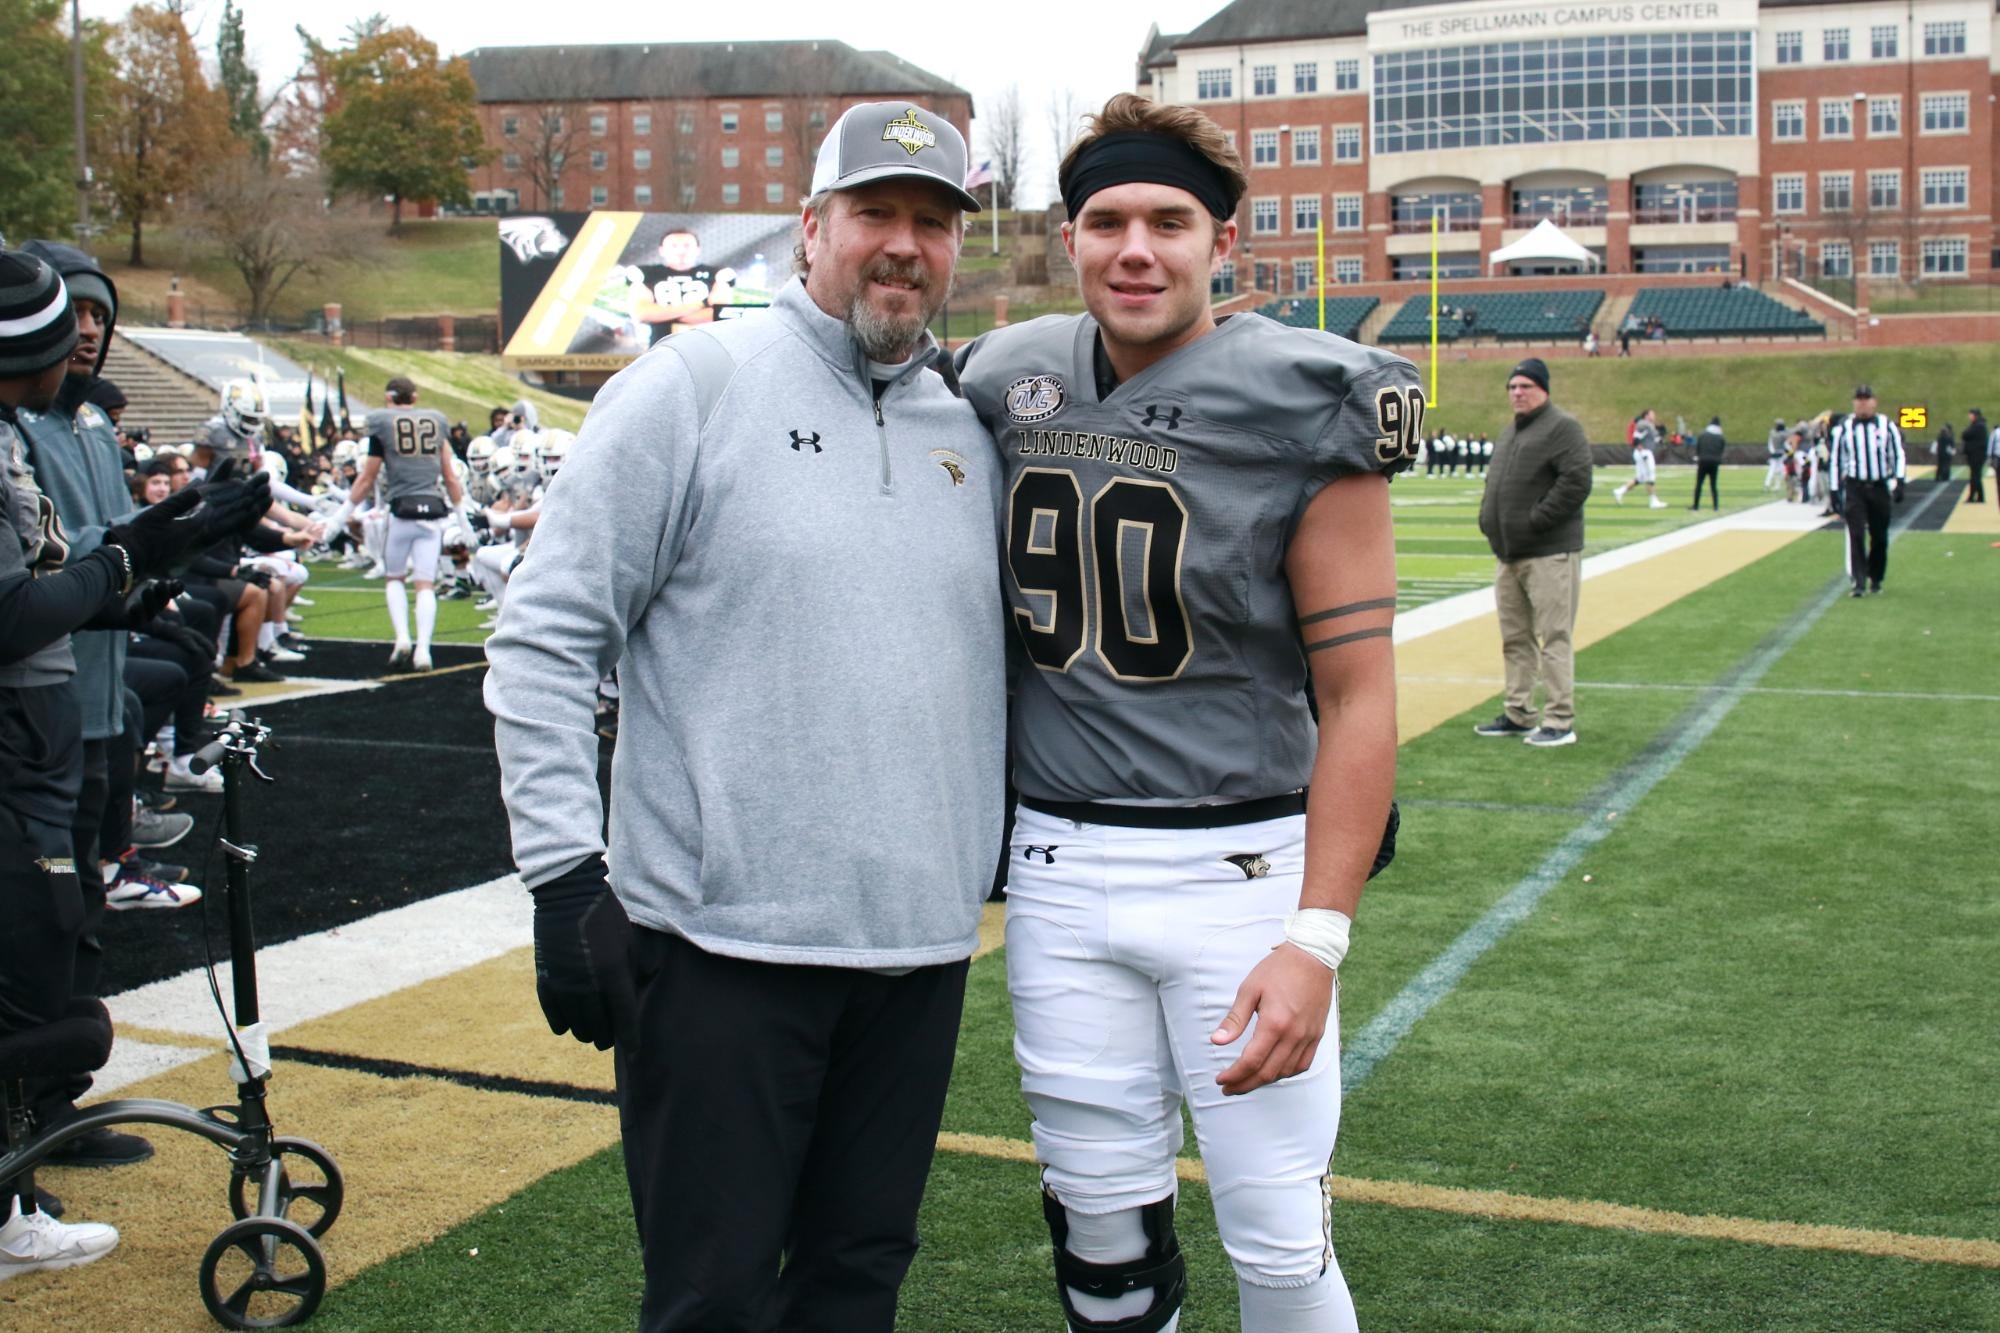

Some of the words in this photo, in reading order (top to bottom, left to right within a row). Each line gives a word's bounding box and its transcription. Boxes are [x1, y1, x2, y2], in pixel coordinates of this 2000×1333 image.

[1401, 21, 1433, 38] THE
[1440, 12, 1547, 35] SPELLMANN
[1554, 5, 1634, 26] CAMPUS
[1641, 2, 1719, 21] CENTER
[886, 125, 935, 146] LINDENWOOD
[516, 357, 576, 368] SIMMONS
[1012, 388, 1053, 411] OVC
[1900, 407, 1926, 428] 25
[394, 416, 439, 457] 82
[1375, 385, 1426, 463] 90
[1018, 429, 1179, 474] LINDENWOOD
[1007, 466, 1195, 683] 90
